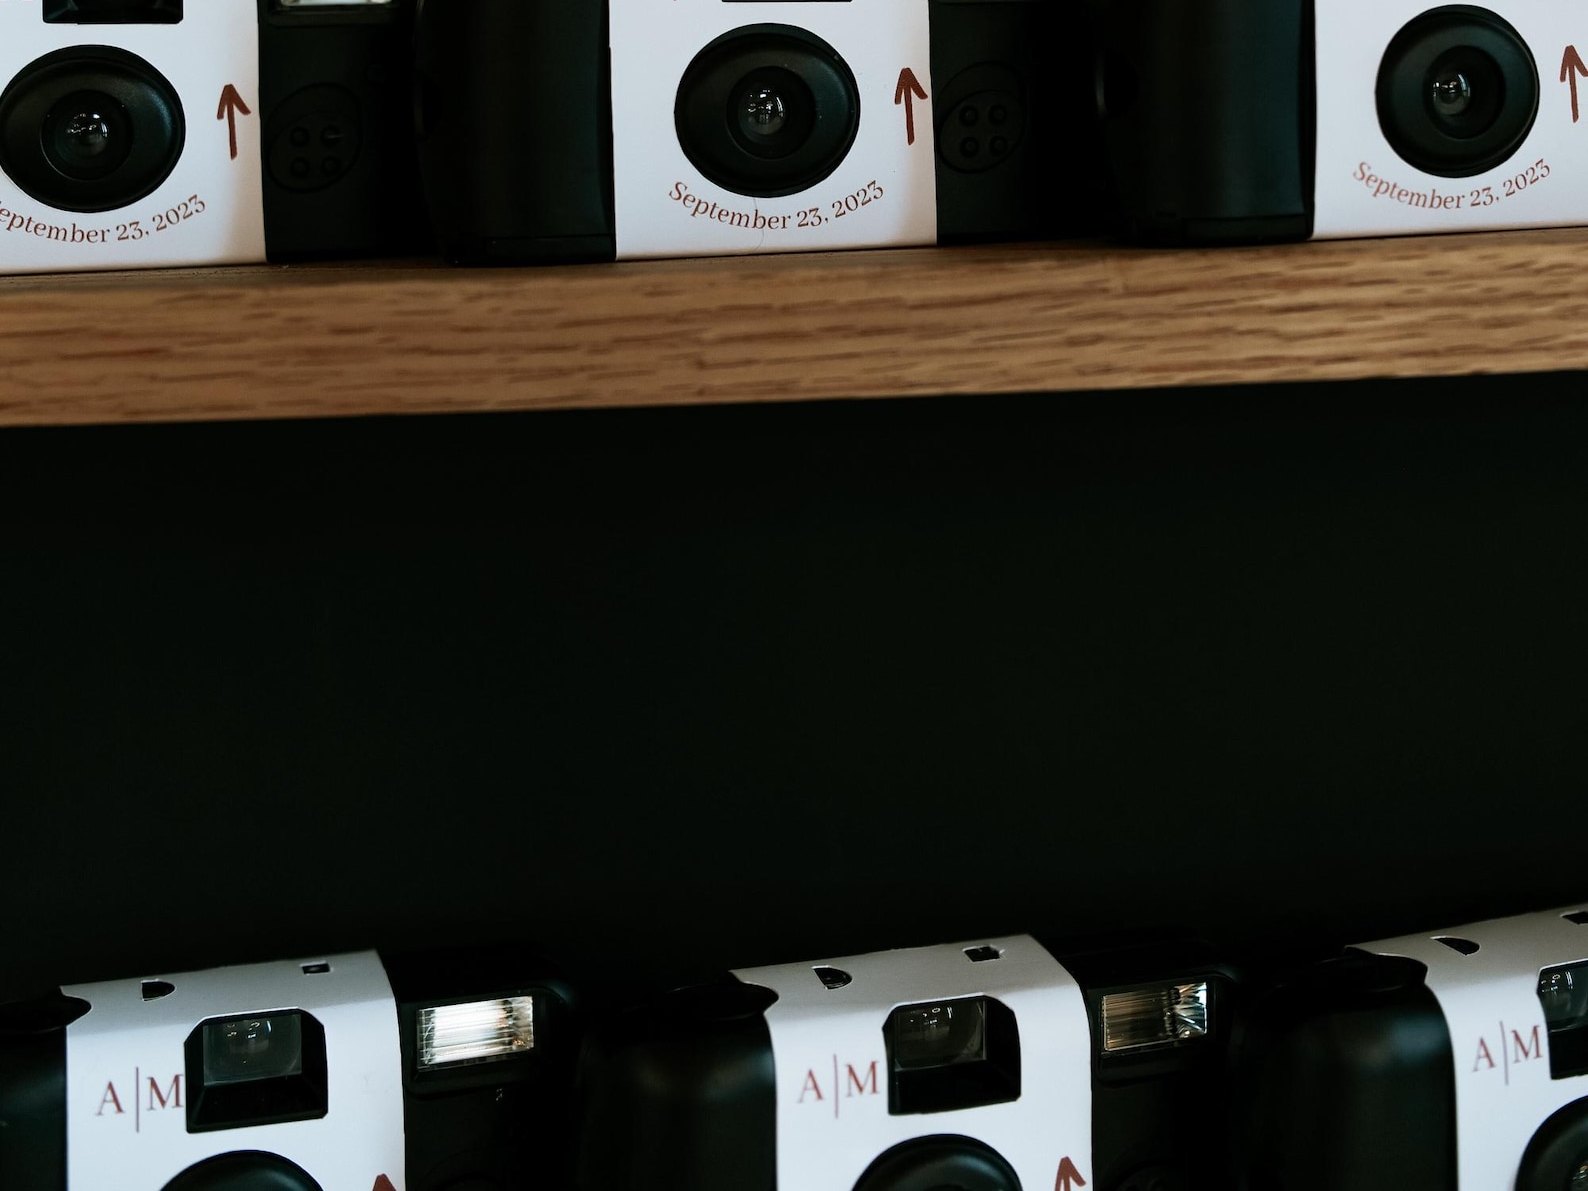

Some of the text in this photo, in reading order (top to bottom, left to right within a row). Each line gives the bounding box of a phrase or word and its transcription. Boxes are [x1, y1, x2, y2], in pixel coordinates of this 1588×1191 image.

[668, 180, 884, 230] September 23, 2023
[1353, 158, 1551, 209] September 23, 2023
[0, 194, 206, 243] eptember 23, 2023
